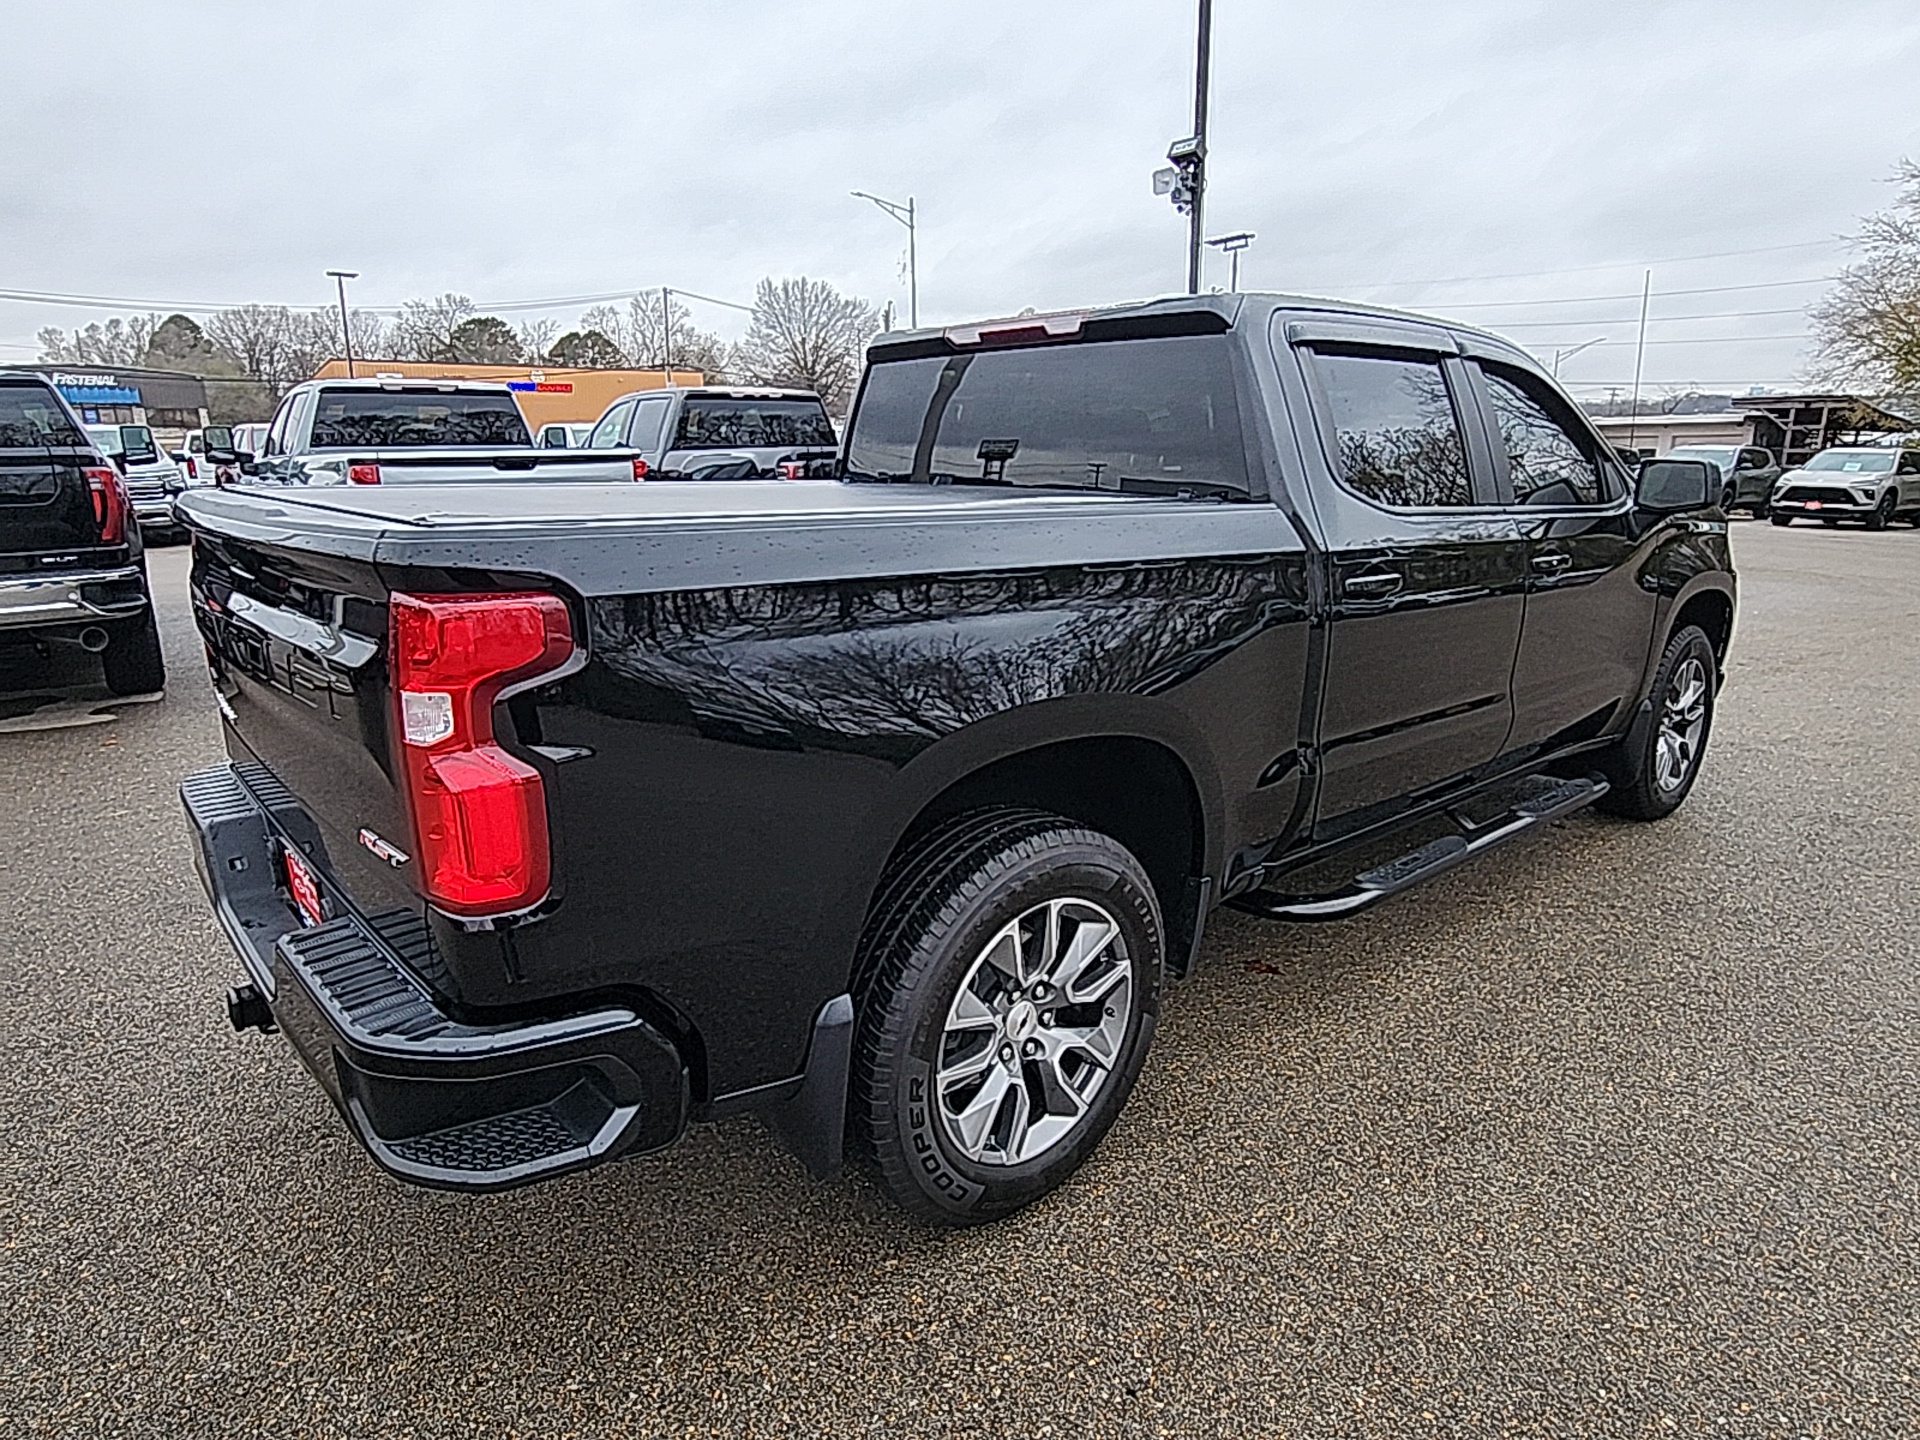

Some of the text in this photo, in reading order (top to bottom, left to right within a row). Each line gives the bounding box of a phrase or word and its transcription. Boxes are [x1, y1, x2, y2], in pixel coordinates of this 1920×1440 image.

[52, 372, 118, 386] FASTENAL
[359, 828, 410, 868] RST
[908, 1077, 969, 1202] COOPER
